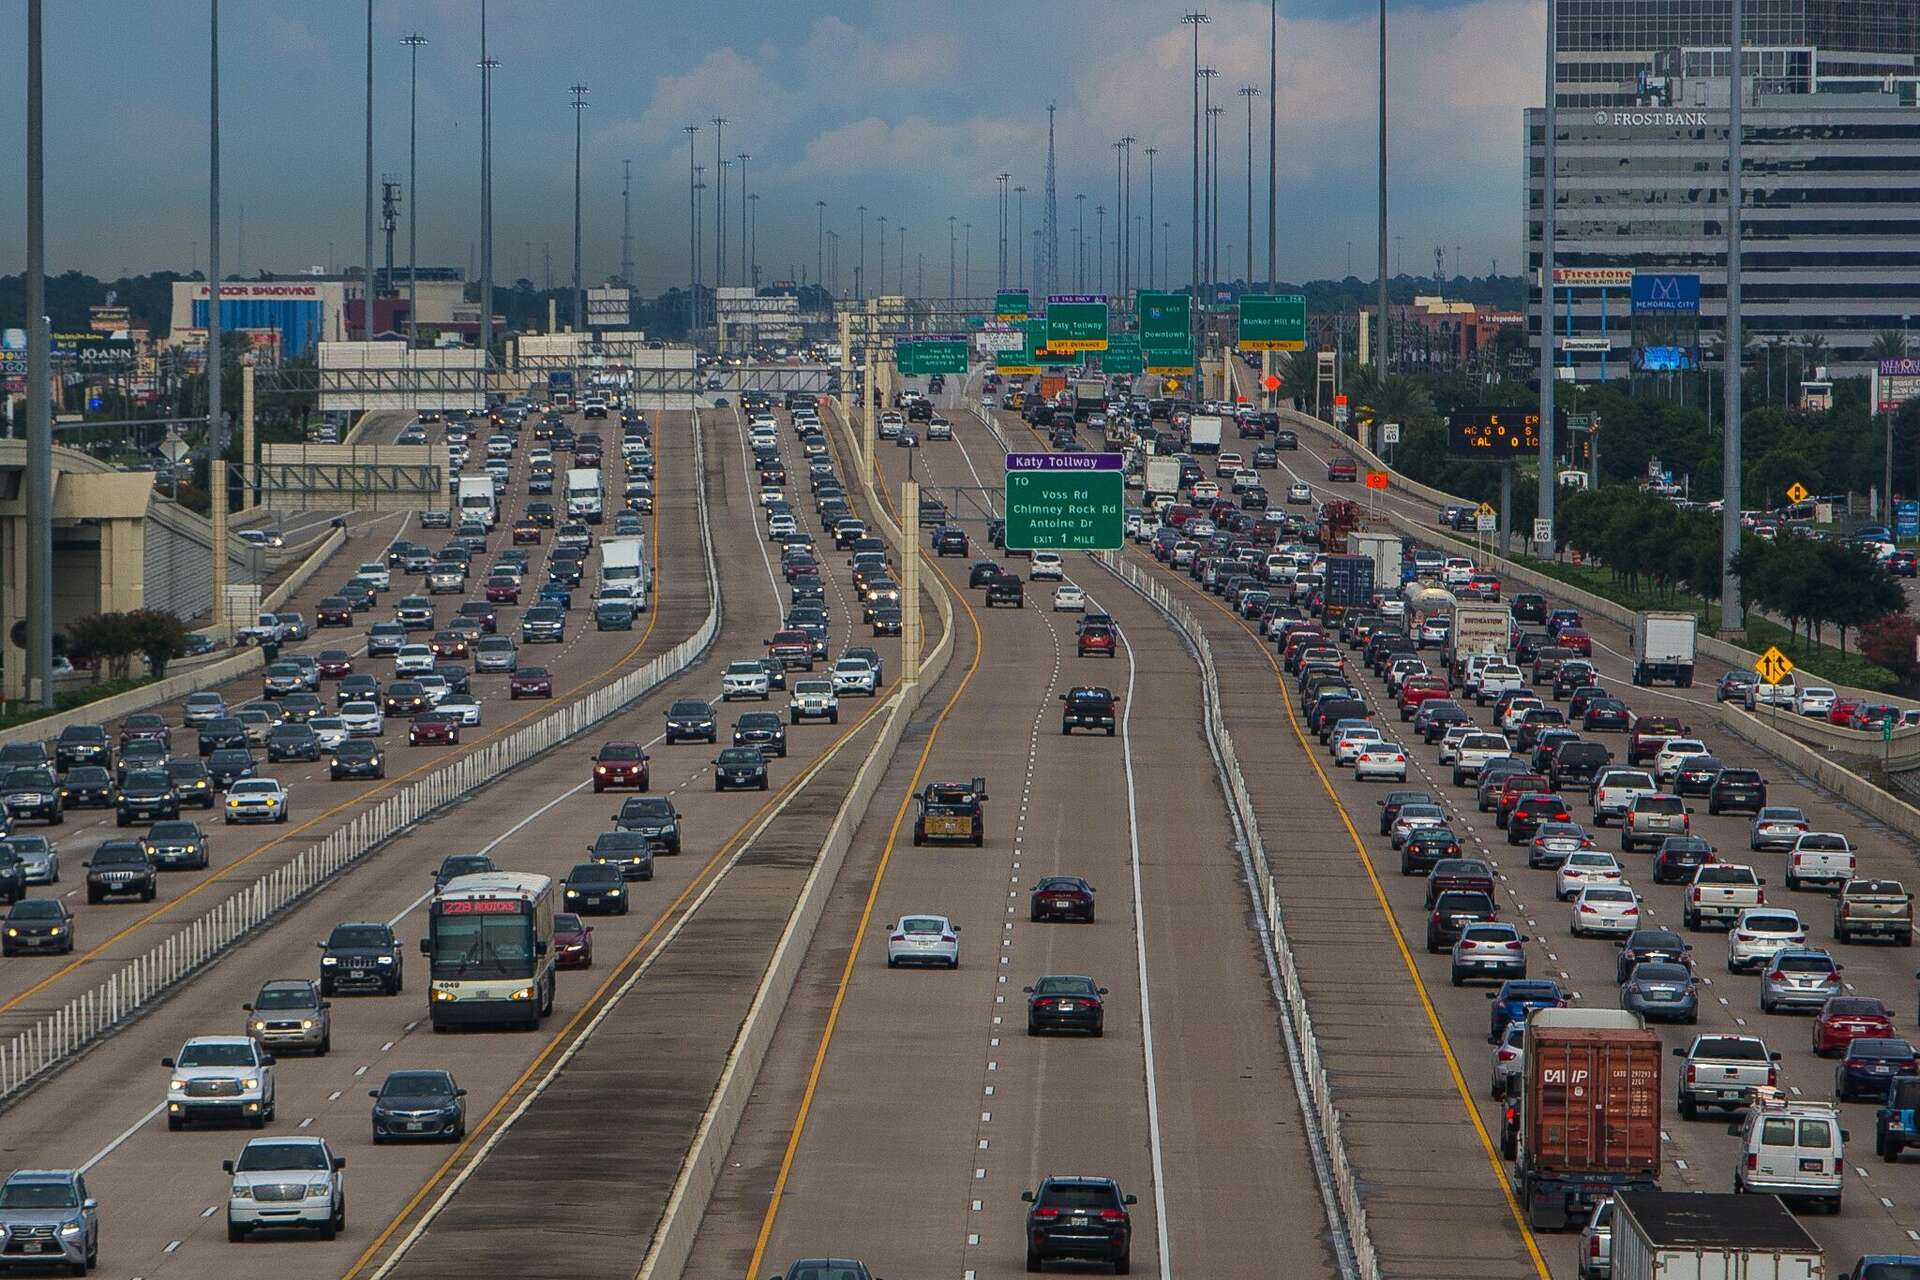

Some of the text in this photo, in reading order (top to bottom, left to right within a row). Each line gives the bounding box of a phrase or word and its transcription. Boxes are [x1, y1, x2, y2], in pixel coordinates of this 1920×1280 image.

[1614, 113, 1707, 126] FROST BANK
[1564, 269, 1633, 280] Firestone
[252, 287, 316, 296] SKYDIVING
[1052, 322, 1102, 330] Katy Tollway
[1016, 457, 1097, 469] Katy Tollway
[1014, 477, 1029, 486] TO
[1042, 490, 1088, 499] Voss Rd
[1014, 504, 1116, 515] Chimney Rock Rd
[1030, 519, 1093, 528] Antoine Dr
[1061, 533, 1067, 543] 1
